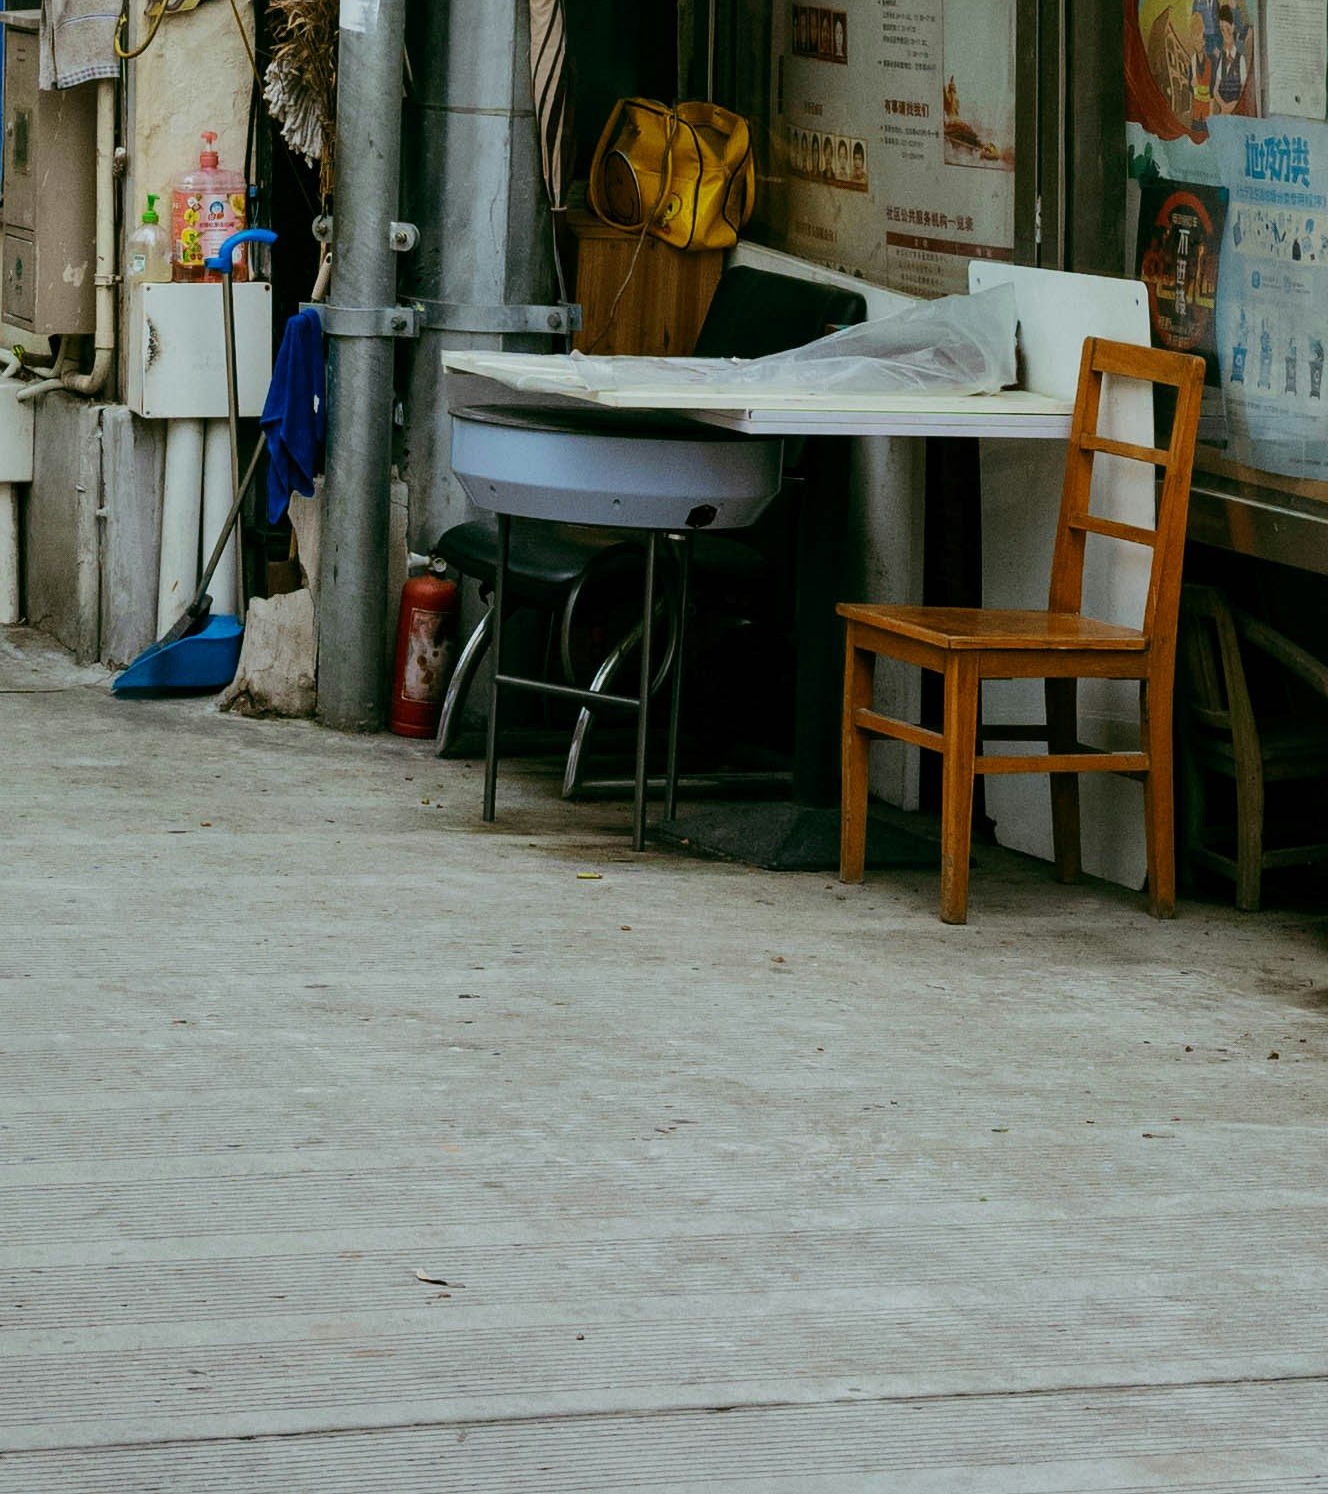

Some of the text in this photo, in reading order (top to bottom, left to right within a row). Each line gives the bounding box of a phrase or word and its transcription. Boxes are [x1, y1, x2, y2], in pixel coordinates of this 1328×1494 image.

[1245, 134, 1310, 188] 垃圾分类
[886, 206, 974, 231] 社区公共服务机构一览表
